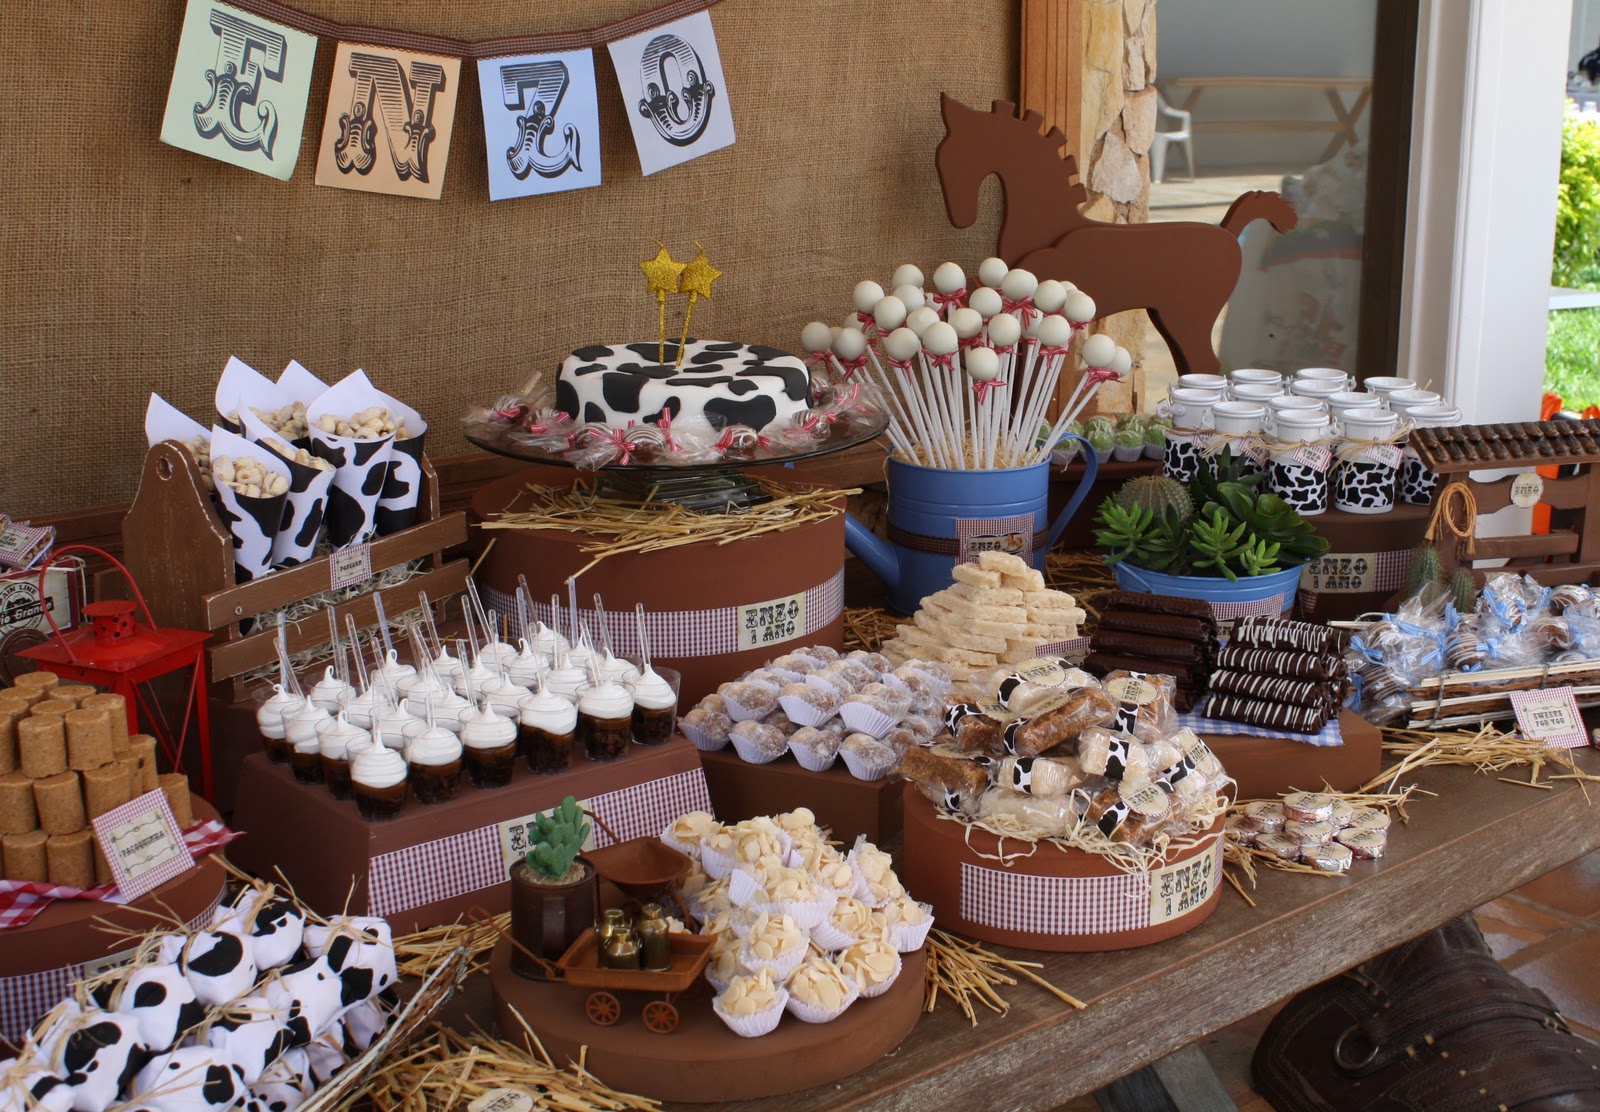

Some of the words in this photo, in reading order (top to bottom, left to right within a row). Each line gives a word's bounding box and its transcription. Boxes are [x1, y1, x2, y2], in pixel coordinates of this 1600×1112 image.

[970, 541, 1002, 552] ENZO
[1309, 558, 1368, 575] ENZO
[1325, 576, 1362, 589] ANO
[20, 585, 37, 596] LINE
[0, 614, 11, 626] io
[746, 600, 799, 629] ENZO
[763, 621, 795, 641] ANO
[1533, 710, 1563, 720] SWEETS
[1535, 719, 1549, 727] FOR
[1551, 717, 1565, 725] YOU
[1128, 787, 1160, 807] ENZO
[1160, 855, 1211, 898] ENZO
[1178, 881, 1208, 911] ANO
